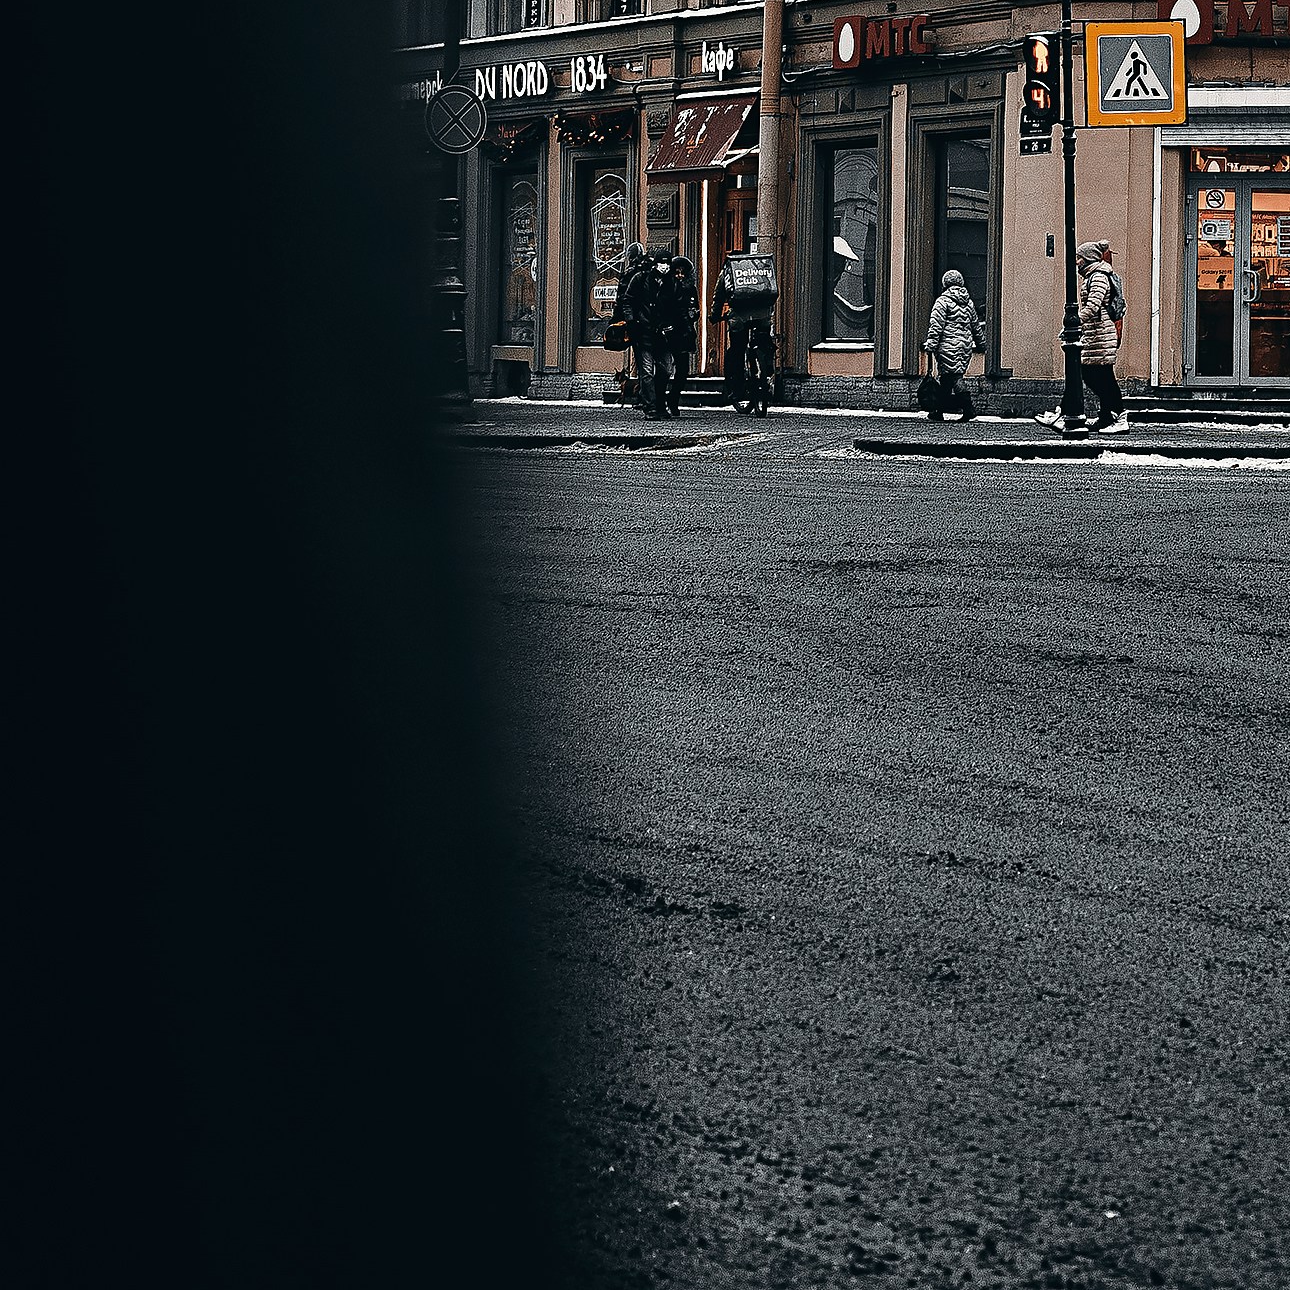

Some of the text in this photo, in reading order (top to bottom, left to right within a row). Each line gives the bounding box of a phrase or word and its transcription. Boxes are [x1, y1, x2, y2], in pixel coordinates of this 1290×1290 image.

[866, 14, 933, 60] МТС
[502, 60, 549, 99] NORD
[570, 54, 608, 93] 1834
[702, 41, 734, 81] кафе
[735, 268, 773, 279] Delivery
[736, 277, 759, 286] Club
